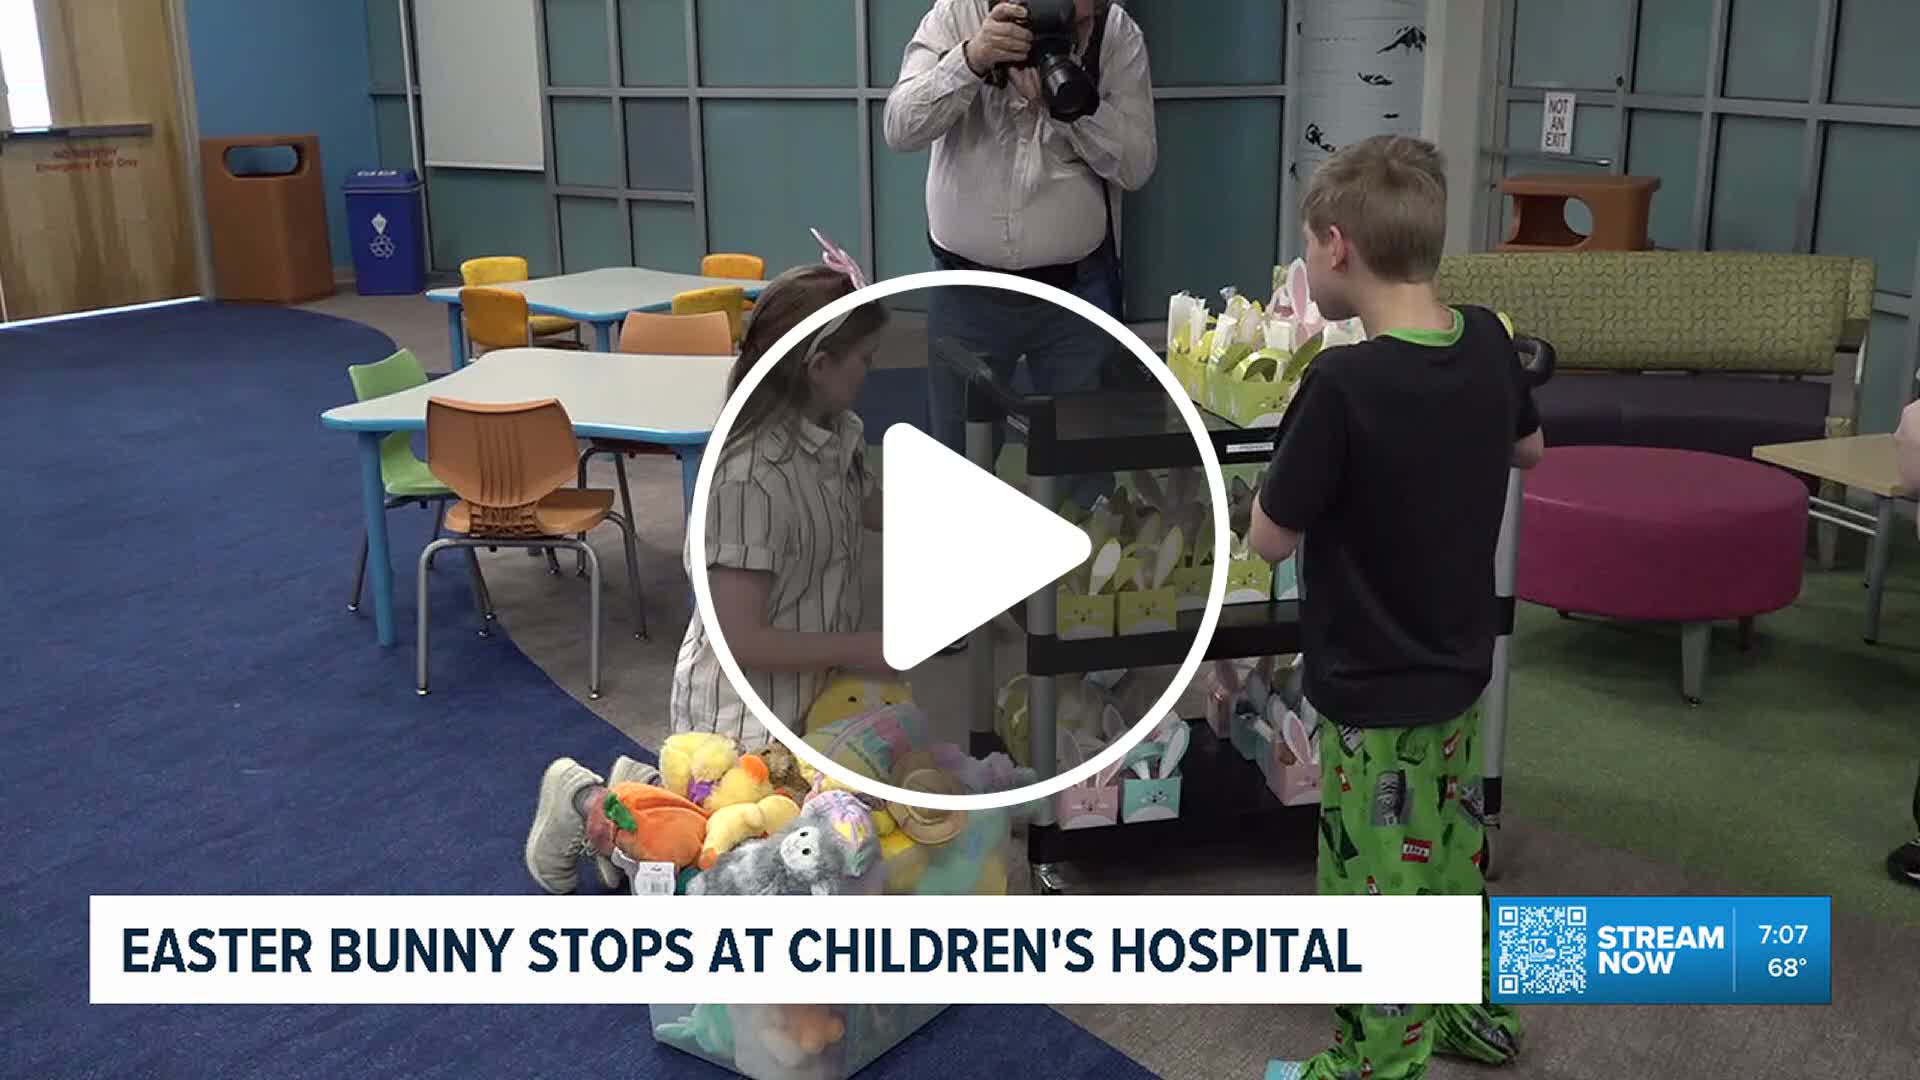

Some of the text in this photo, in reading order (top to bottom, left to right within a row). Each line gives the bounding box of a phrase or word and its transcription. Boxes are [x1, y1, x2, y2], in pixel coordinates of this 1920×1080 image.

[1549, 98, 1569, 114] NOT
[1551, 116, 1565, 130] AN
[1545, 131, 1568, 147] EXIT
